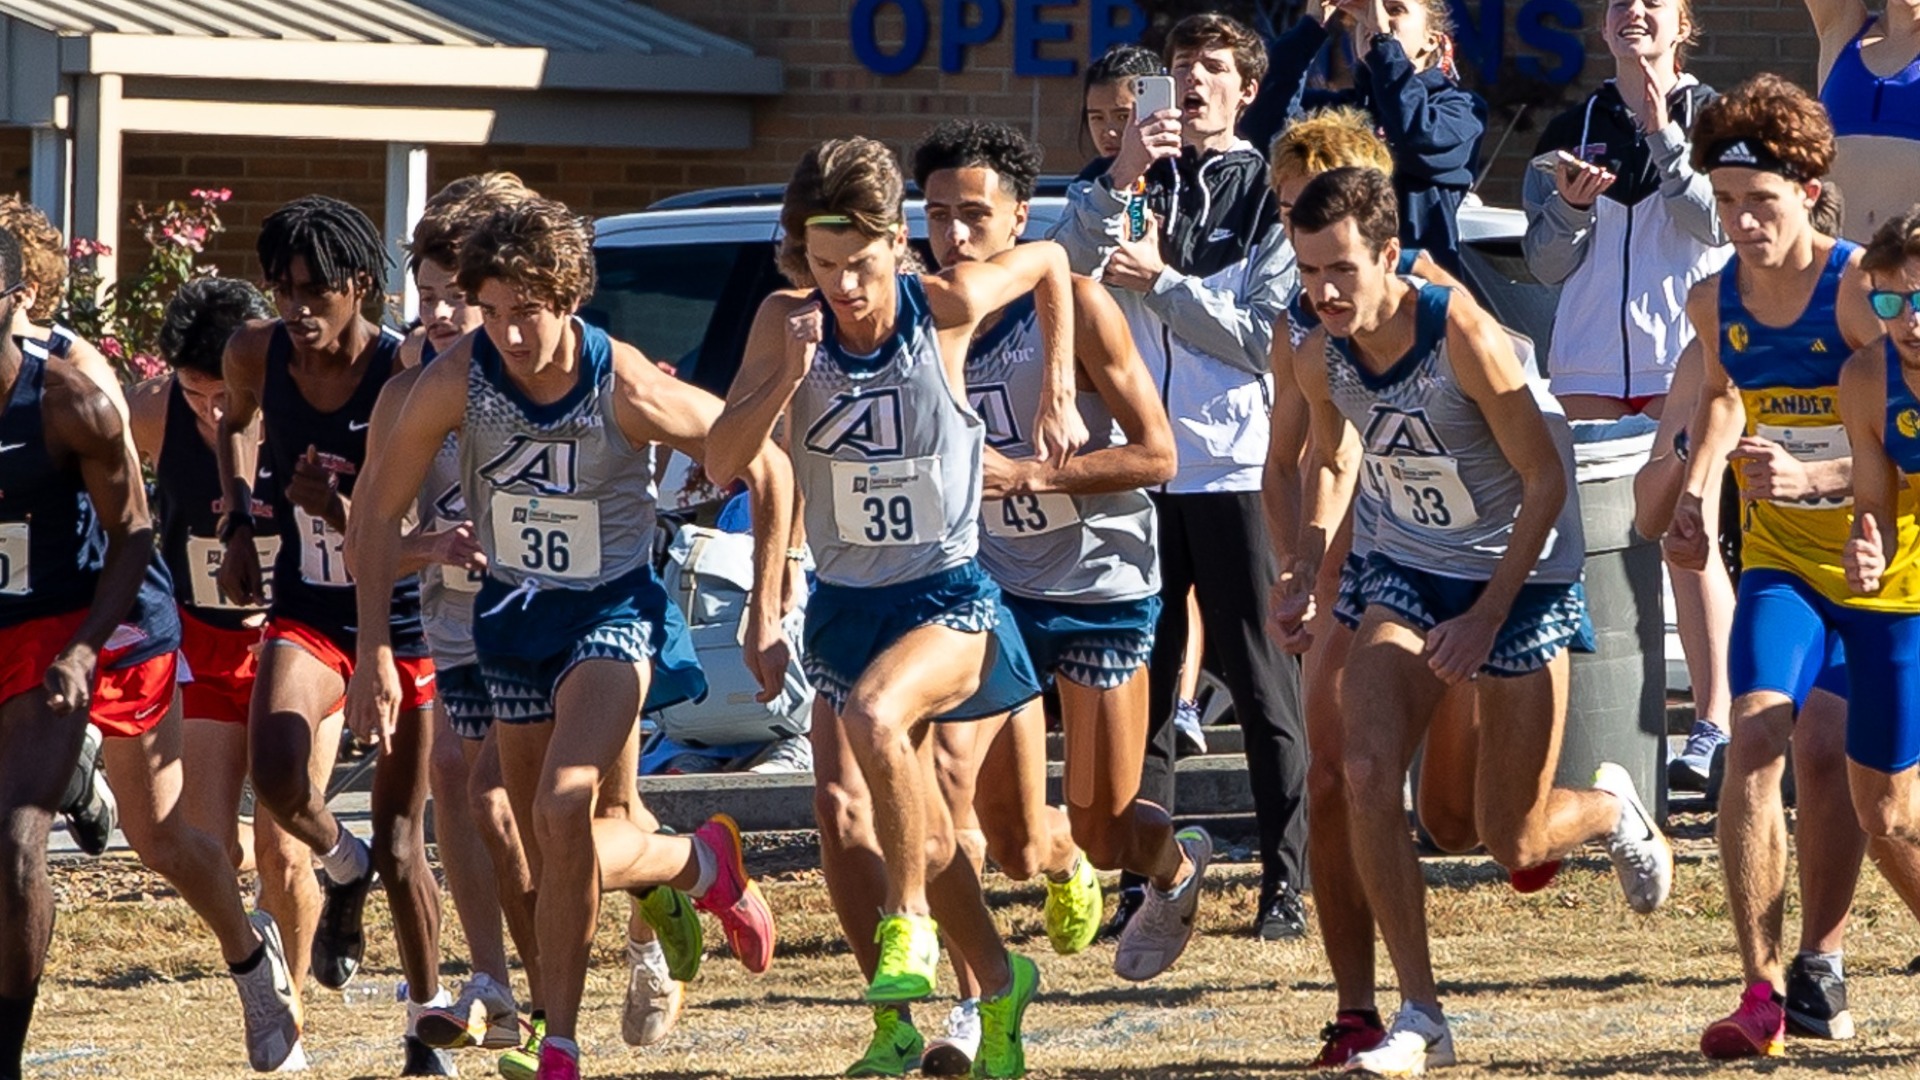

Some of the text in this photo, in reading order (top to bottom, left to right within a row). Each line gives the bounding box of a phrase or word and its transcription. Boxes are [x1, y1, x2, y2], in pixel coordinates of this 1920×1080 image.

[863, 496, 913, 542] 39
[1003, 493, 1047, 532] 43
[1404, 484, 1452, 527] 33
[521, 527, 569, 573] 36
